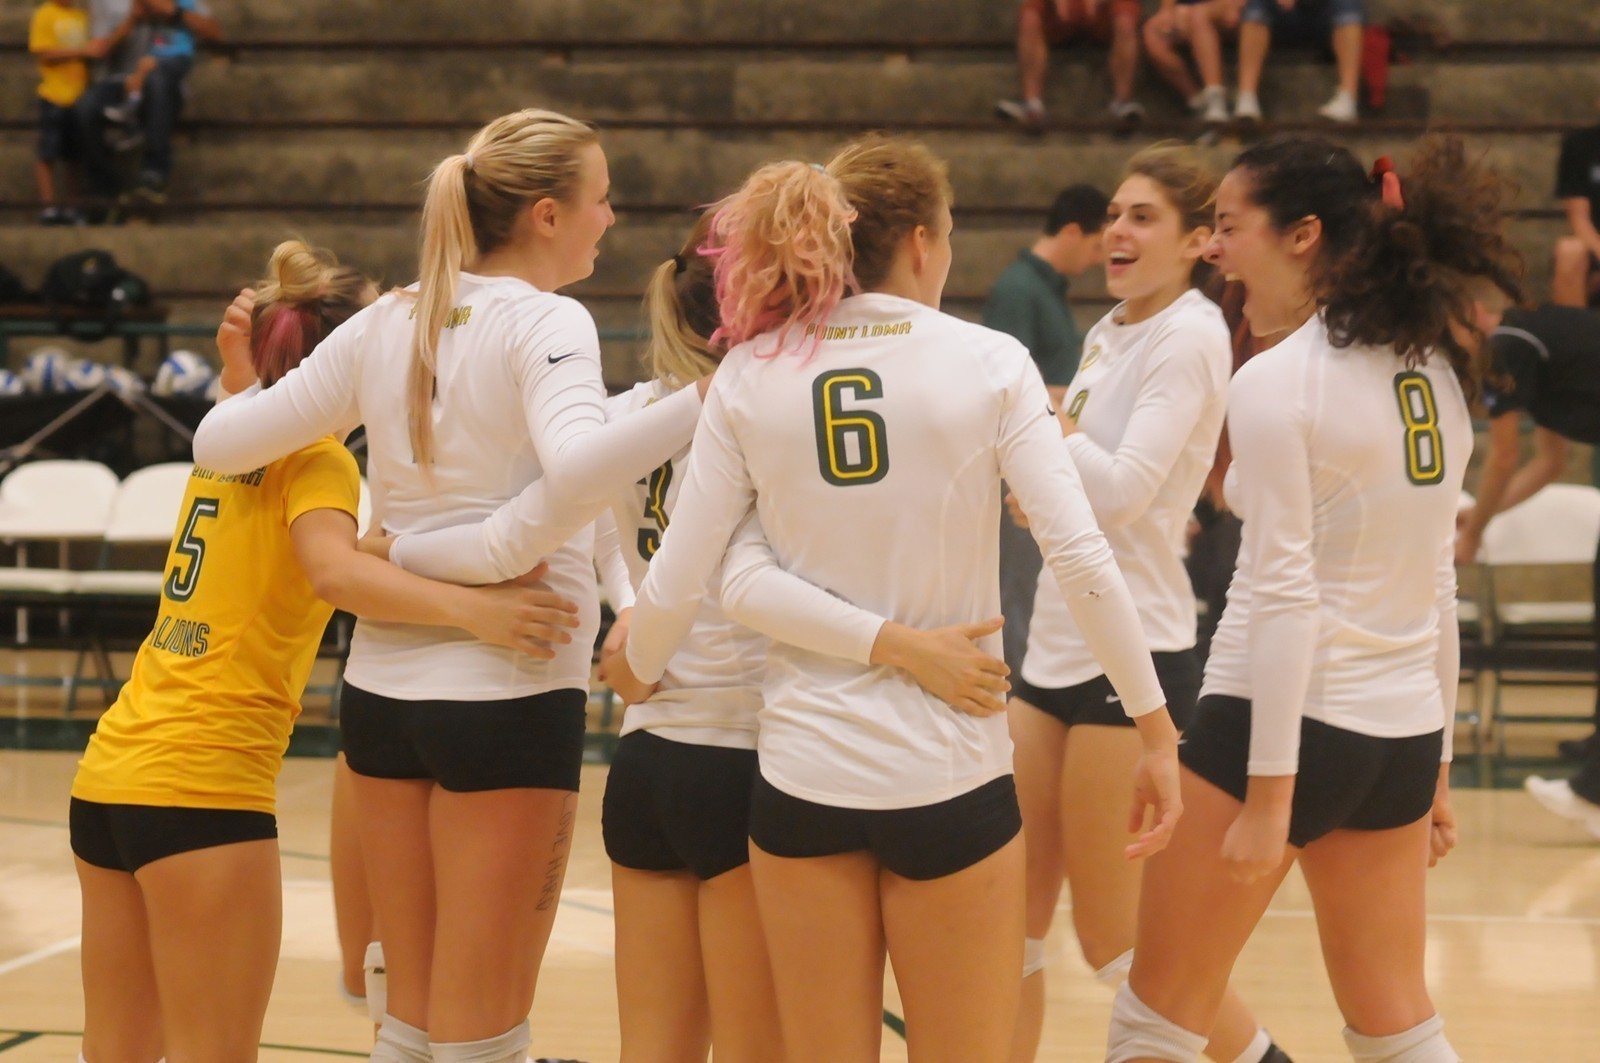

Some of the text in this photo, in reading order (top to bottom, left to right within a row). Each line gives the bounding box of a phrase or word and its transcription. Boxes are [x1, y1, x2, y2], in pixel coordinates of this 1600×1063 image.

[860, 321, 912, 338] LOMA
[812, 367, 889, 487] 6
[1393, 371, 1445, 485] 8
[164, 497, 219, 602] 5
[154, 616, 210, 657] LIONS
